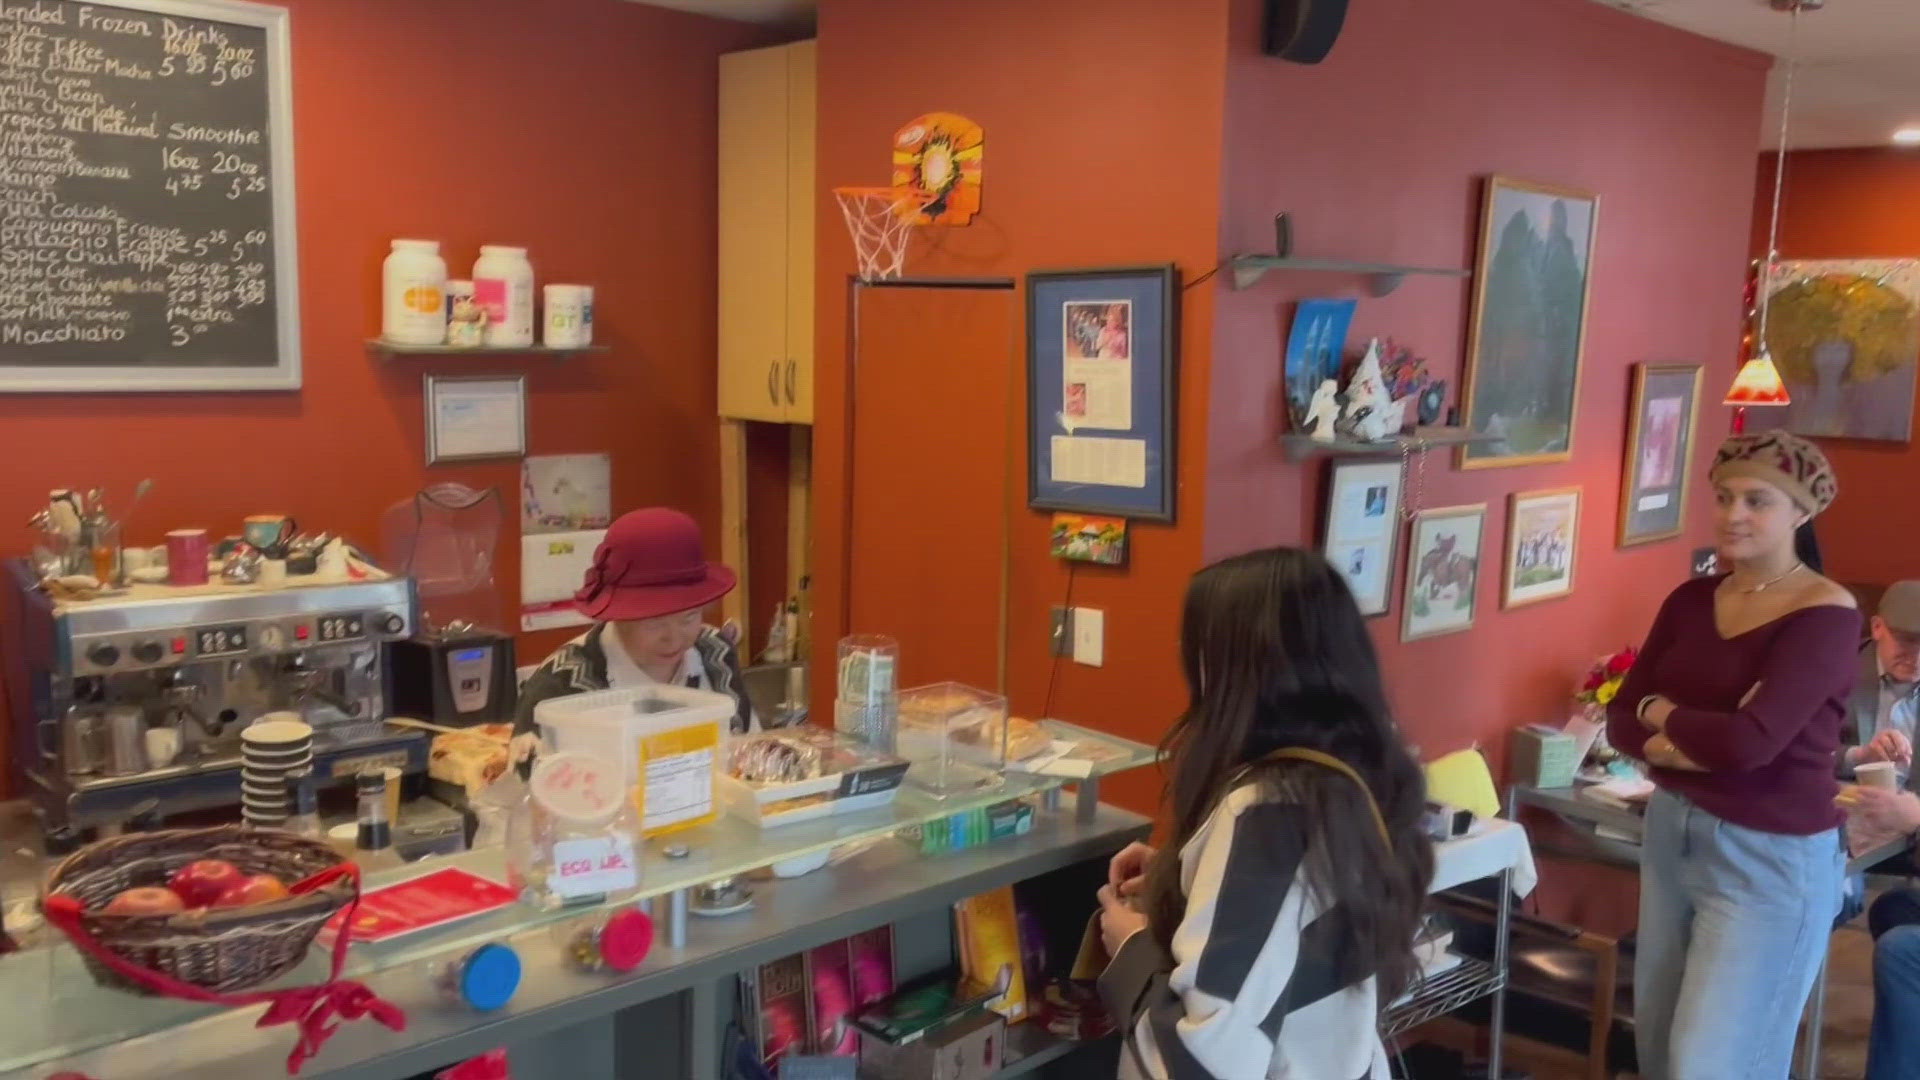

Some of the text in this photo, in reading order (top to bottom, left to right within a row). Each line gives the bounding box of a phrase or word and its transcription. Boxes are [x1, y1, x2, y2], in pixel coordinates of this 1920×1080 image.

[0, 1, 230, 48] lended Frozen Drinks
[0, 32, 44, 56] offee
[0, 80, 105, 104] anilla Bean
[0, 94, 127, 121] hite Chocolate
[0, 112, 56, 134] ropics
[93, 111, 160, 138] Natural
[162, 147, 258, 175] 16oz 20oz
[50, 202, 119, 221] Colada
[1, 227, 109, 250] Pistachio
[0, 245, 60, 267] Spice
[2, 321, 127, 345] Macchiato
